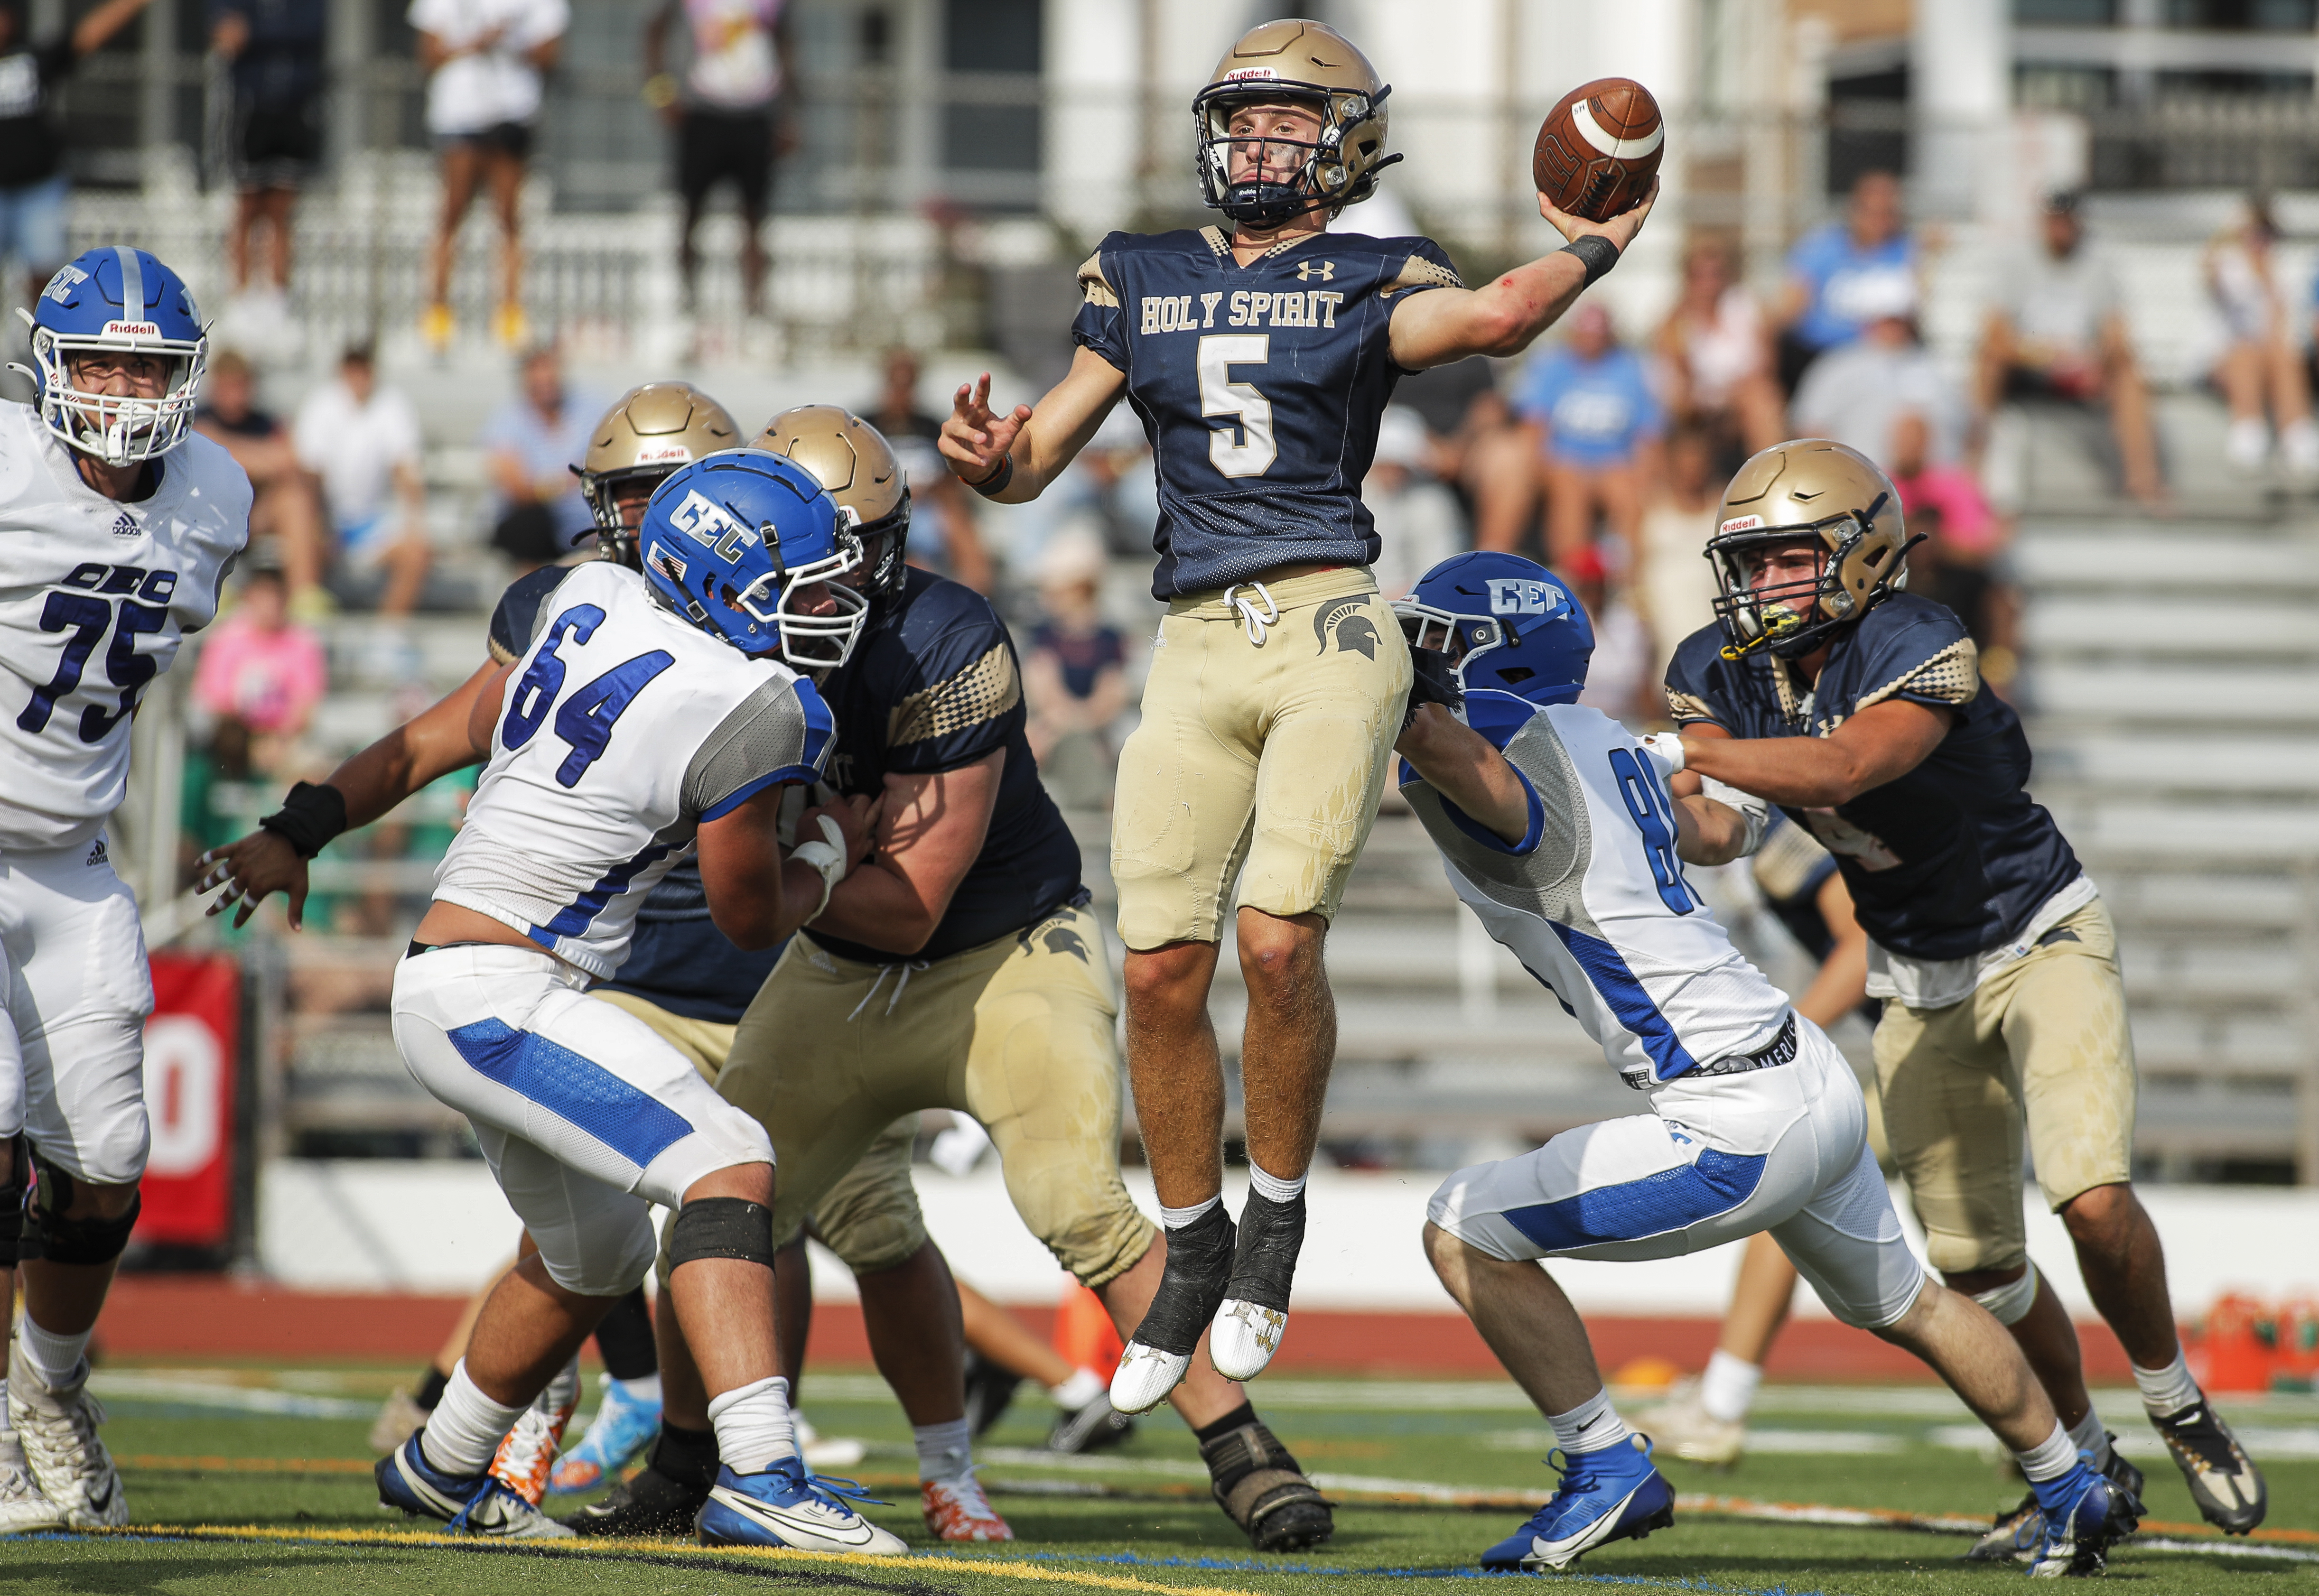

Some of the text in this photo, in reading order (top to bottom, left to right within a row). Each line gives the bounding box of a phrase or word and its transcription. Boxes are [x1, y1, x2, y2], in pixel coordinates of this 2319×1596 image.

[1229, 69, 1271, 81] Riddell
[110, 323, 155, 334] Riddell
[1141, 290, 1344, 335] HOLY SPIRIT
[1197, 334, 1277, 478] 5
[669, 488, 760, 565] CEC
[1723, 518, 1756, 532] Riddell
[61, 563, 178, 604] CEC
[16, 591, 169, 743] 75
[501, 603, 676, 789] 64
